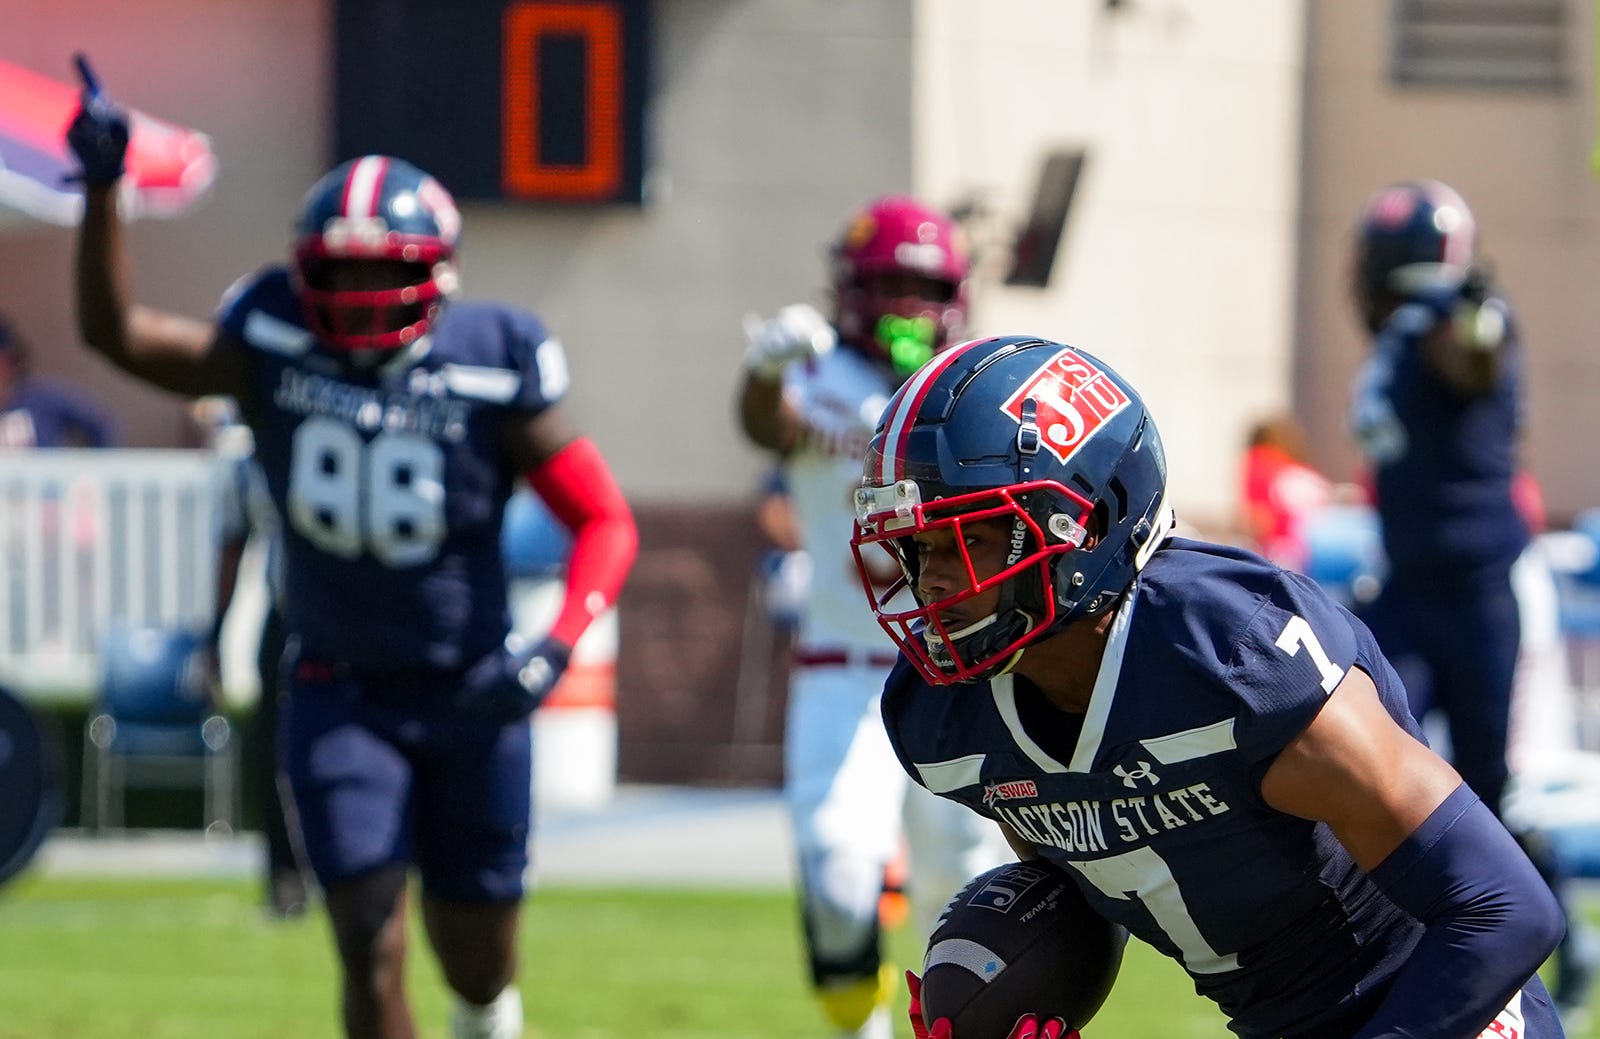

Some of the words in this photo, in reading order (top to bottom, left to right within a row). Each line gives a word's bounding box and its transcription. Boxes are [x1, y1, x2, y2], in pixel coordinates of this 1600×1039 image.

[503, 2, 623, 199] 0
[1007, 514, 1028, 566] Ridde
[1274, 614, 1345, 696] 7
[997, 781, 1038, 799] SWAC
[1111, 782, 1231, 843] STATE
[1066, 845, 1246, 975] 7
